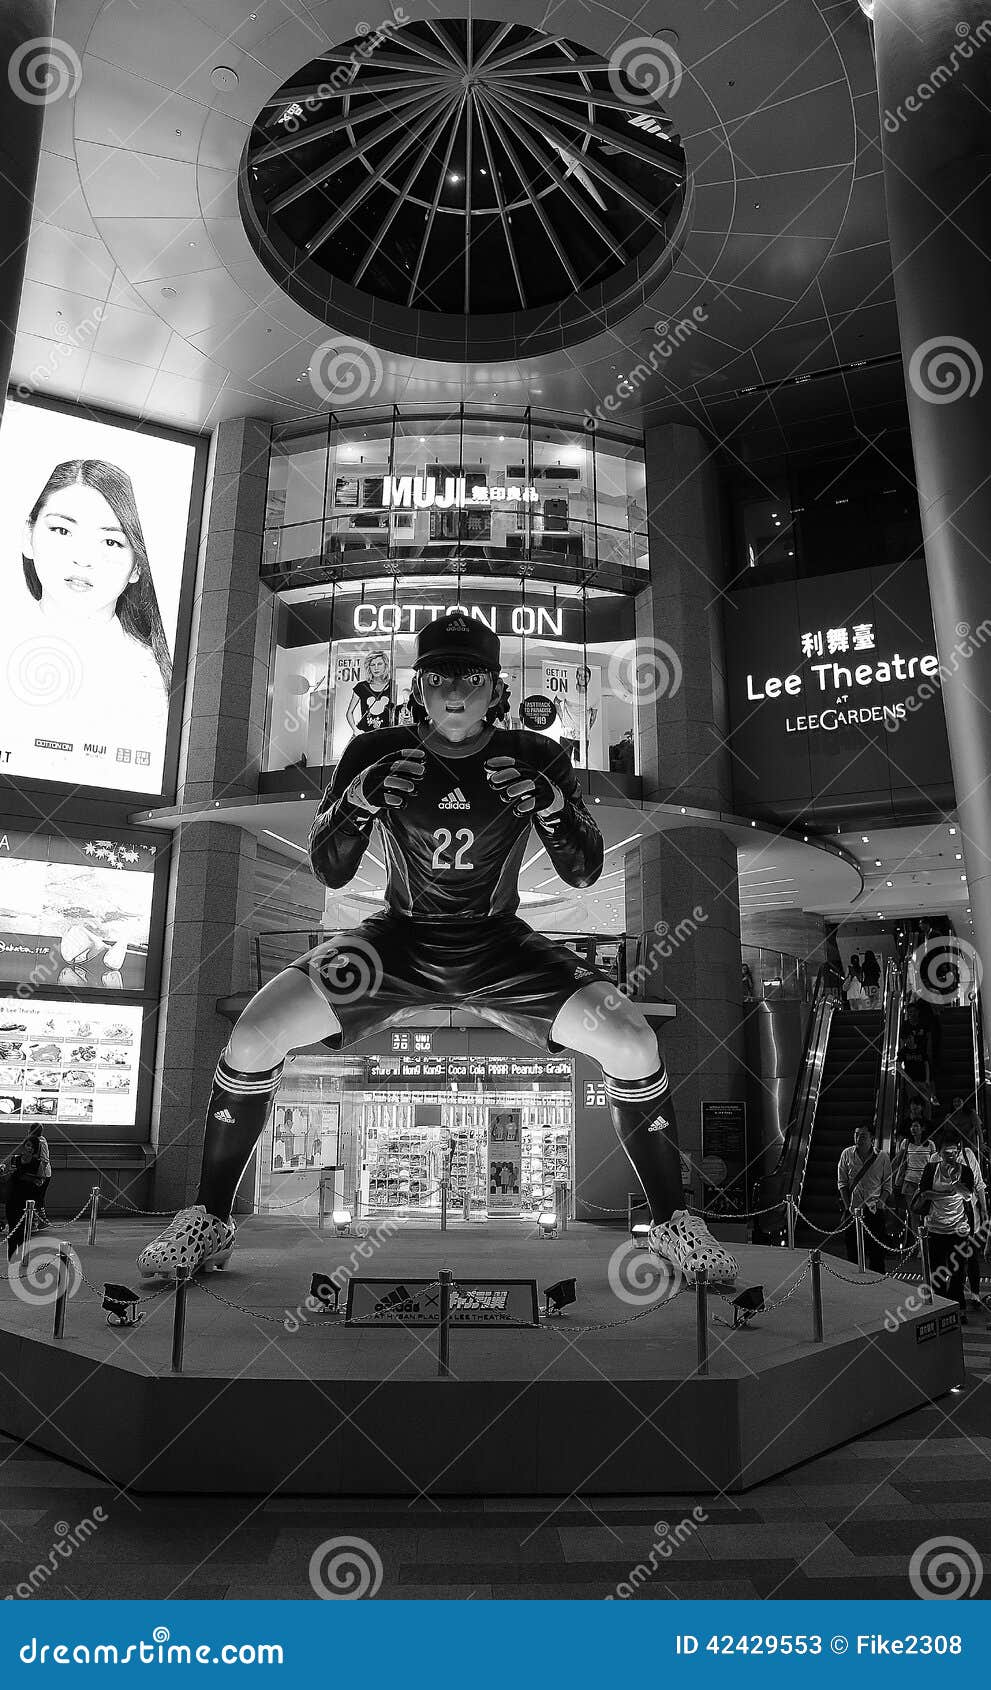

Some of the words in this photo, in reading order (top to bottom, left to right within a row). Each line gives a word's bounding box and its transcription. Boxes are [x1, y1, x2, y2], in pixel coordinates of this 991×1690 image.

[382, 475, 466, 508] MUJI
[471, 485, 539, 502] 無印良品
[353, 604, 497, 633] COTTN
[511, 606, 564, 636] ON
[801, 623, 876, 658] 利舞臺
[338, 659, 351, 668] GET
[545, 668, 560, 677] GET
[560, 669, 568, 678] IT
[746, 674, 802, 701] Lee
[811, 653, 939, 691] Theatre
[836, 695, 849, 705] AT
[83, 743, 107, 755] MUJI
[438, 801, 471, 810] adidas
[431, 828, 475, 870] 22
[448, 1065, 467, 1075] Coca
[469, 1065, 485, 1075] Cola
[511, 1064, 543, 1075] Peanuts
